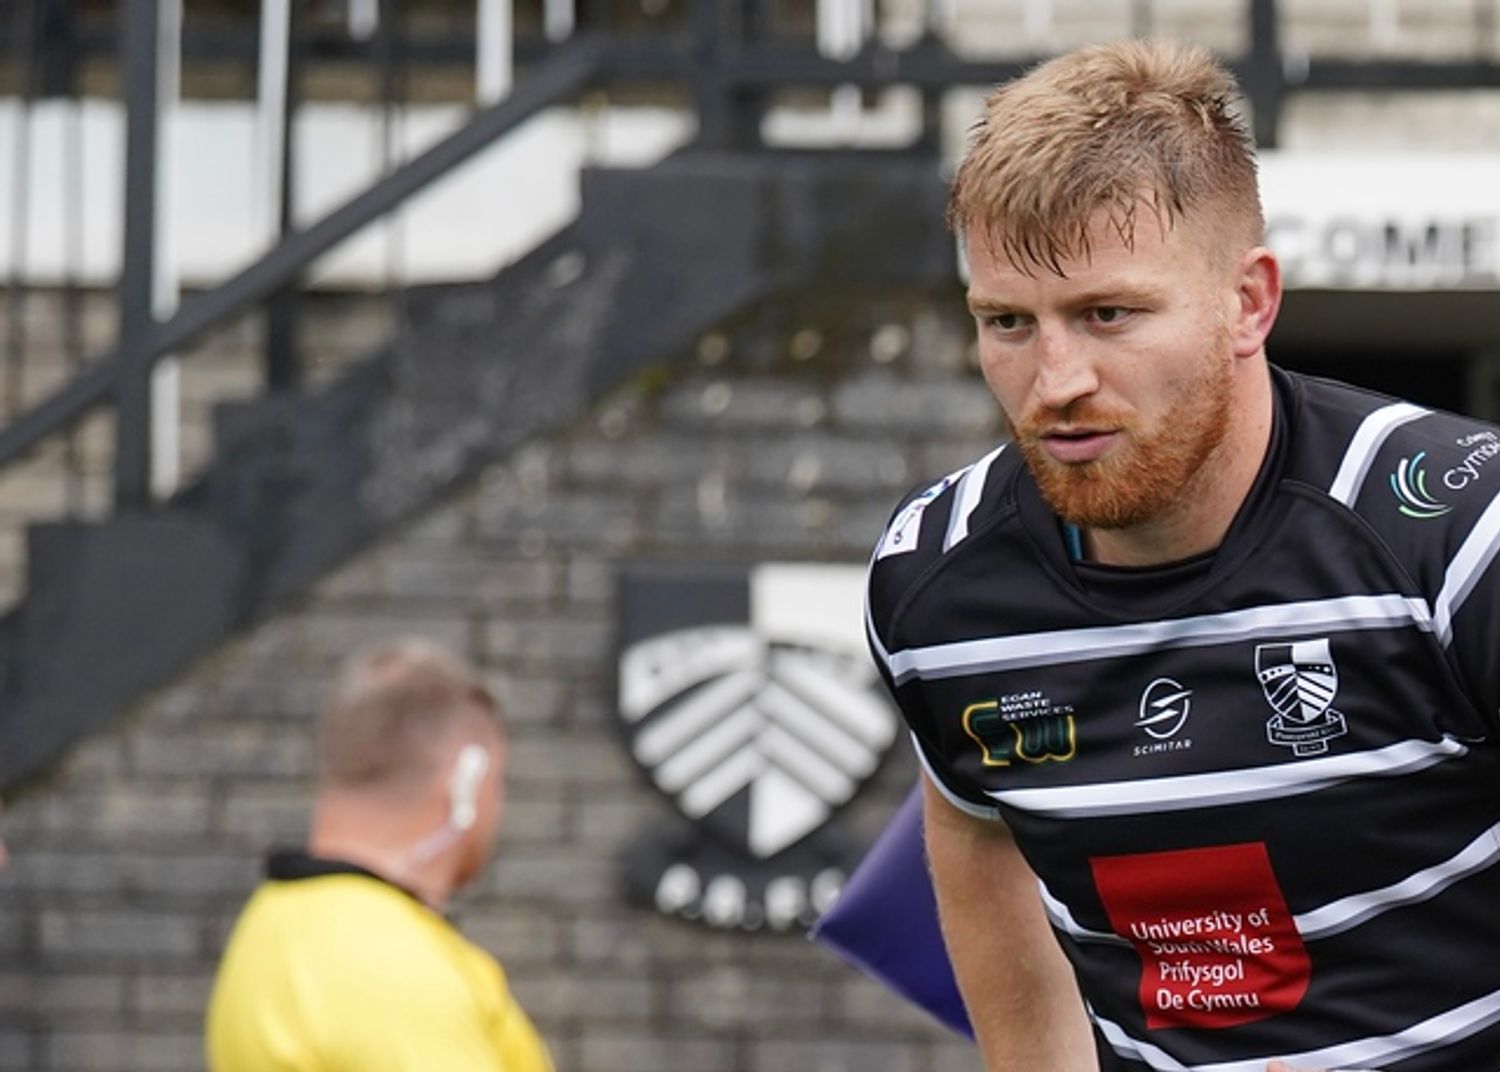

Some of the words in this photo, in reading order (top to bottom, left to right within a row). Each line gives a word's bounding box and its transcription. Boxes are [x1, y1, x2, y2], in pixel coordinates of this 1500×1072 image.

[1266, 214, 1500, 282] COME
[1133, 739, 1193, 757] SCIMITAR
[1131, 910, 1243, 940] University
[1248, 908, 1271, 928] of
[1148, 941, 1205, 956] South
[1205, 934, 1275, 956] Wales
[1159, 959, 1245, 987] Prifysgol
[1156, 988, 1184, 1010] De
[1187, 989, 1261, 1012] Cymru
